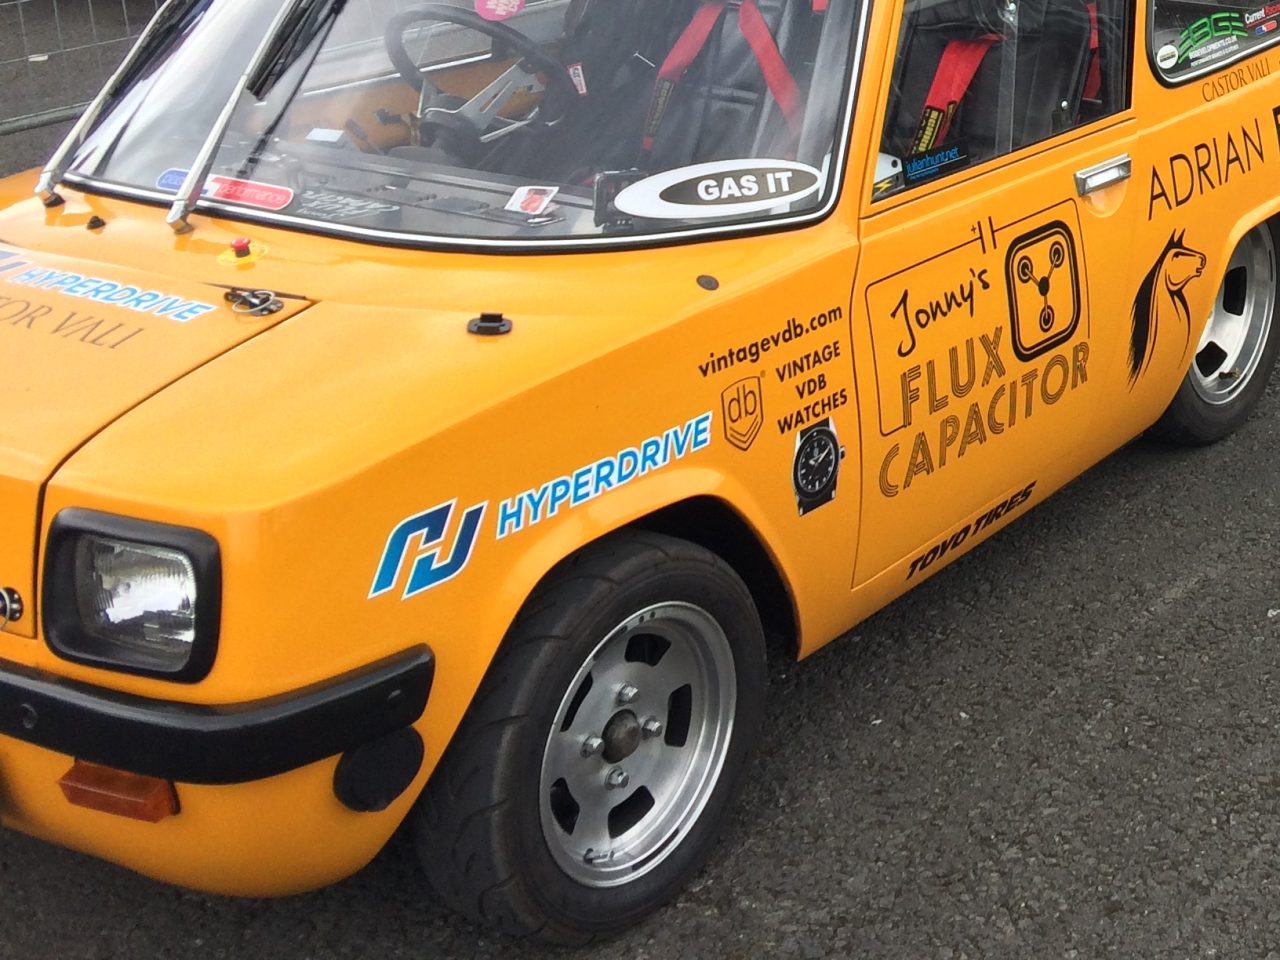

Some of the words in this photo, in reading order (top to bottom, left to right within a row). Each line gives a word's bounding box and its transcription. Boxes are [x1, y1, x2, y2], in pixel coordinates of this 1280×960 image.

[1245, 8, 1265, 24] Current
[1202, 68, 1247, 102] CASTOR
[1247, 57, 1271, 83] VALI
[906, 147, 960, 174] julianhunt.net
[1148, 118, 1265, 221] ADRIAN
[697, 174, 759, 201] GAS
[766, 171, 793, 193] IT
[12, 269, 214, 321] HYPERDRIVE
[890, 268, 990, 357] Jonny's
[51, 311, 144, 349] VALI
[698, 306, 843, 378] vintagevdb.com
[775, 341, 841, 383] VINTAGE
[900, 326, 1006, 428] FLUX
[728, 384, 757, 423] db
[795, 373, 827, 400] VDB
[777, 388, 848, 435] WATCHES
[879, 342, 1090, 498] CAPACITOR
[497, 414, 711, 538] HYPERDRIVE
[906, 524, 971, 581] TOYO
[971, 480, 1038, 537] TIRES
